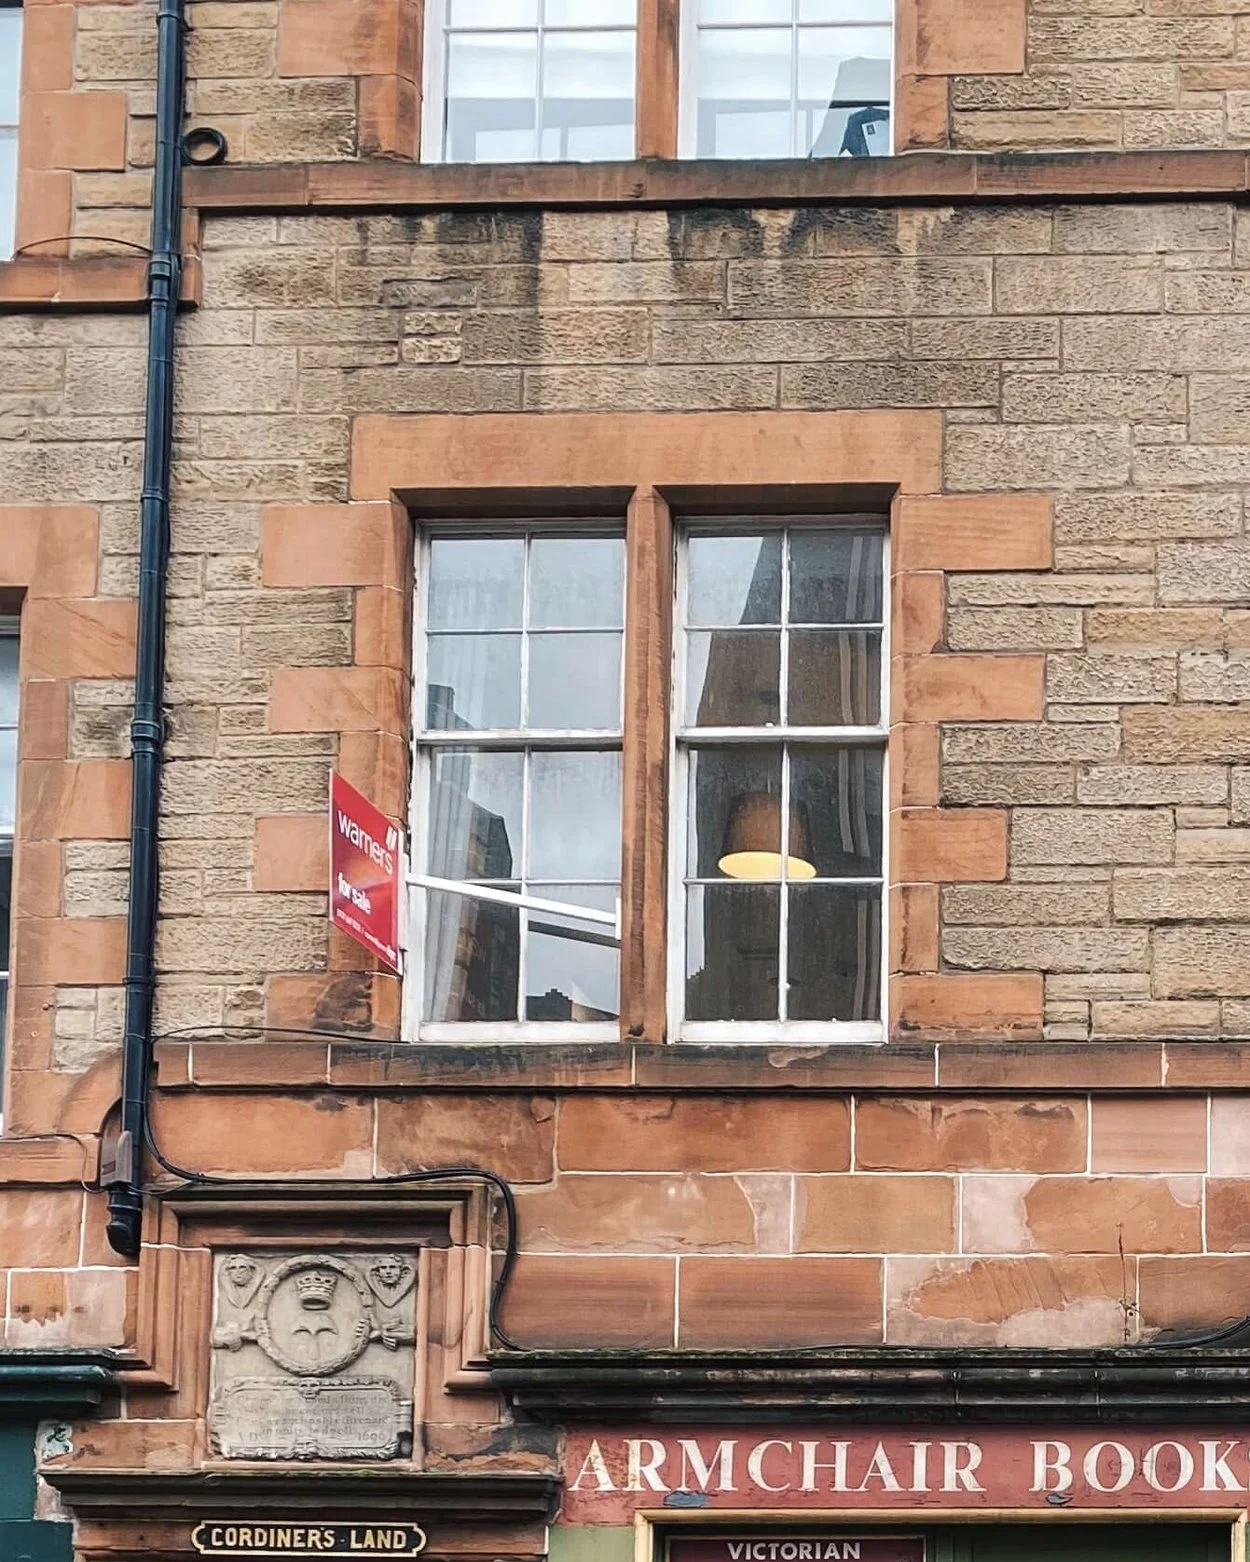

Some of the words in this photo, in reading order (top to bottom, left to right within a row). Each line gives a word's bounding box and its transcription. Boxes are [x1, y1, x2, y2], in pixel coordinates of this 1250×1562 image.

[338, 810, 393, 876] warners
[337, 873, 352, 899] for
[351, 886, 372, 915] sale
[357, 1431, 386, 1442] 1696
[567, 1438, 988, 1492] ARMCHAIR
[211, 1527, 336, 1550] CORDINER'S
[350, 1529, 407, 1549] LAND
[727, 1542, 861, 1560] VICTORIAN
